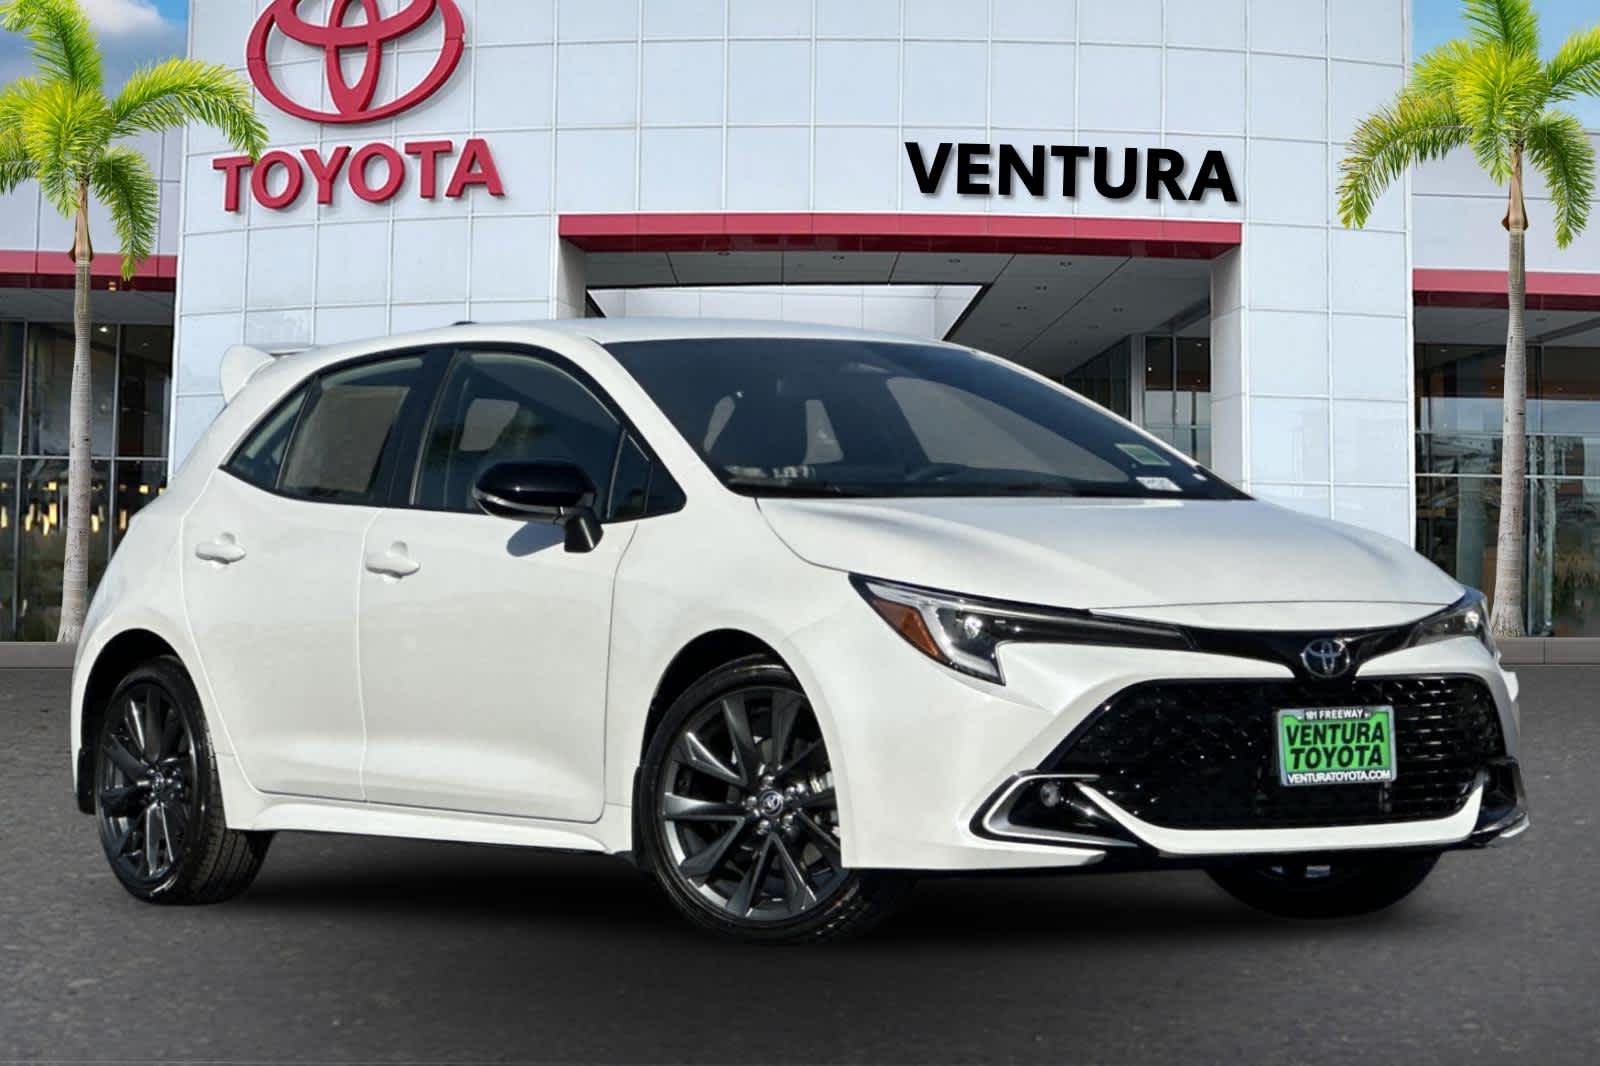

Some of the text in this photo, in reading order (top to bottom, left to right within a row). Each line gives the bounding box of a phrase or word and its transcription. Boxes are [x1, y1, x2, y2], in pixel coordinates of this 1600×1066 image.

[212, 138, 505, 212] TOYOTA
[905, 141, 1238, 203] VENTURA
[1305, 709, 1364, 720] 101 FREEWAY
[1286, 722, 1385, 746] VENTURA
[1290, 744, 1383, 769] TOYOTA
[1287, 770, 1391, 784] VENTURATOYOTA.COM
